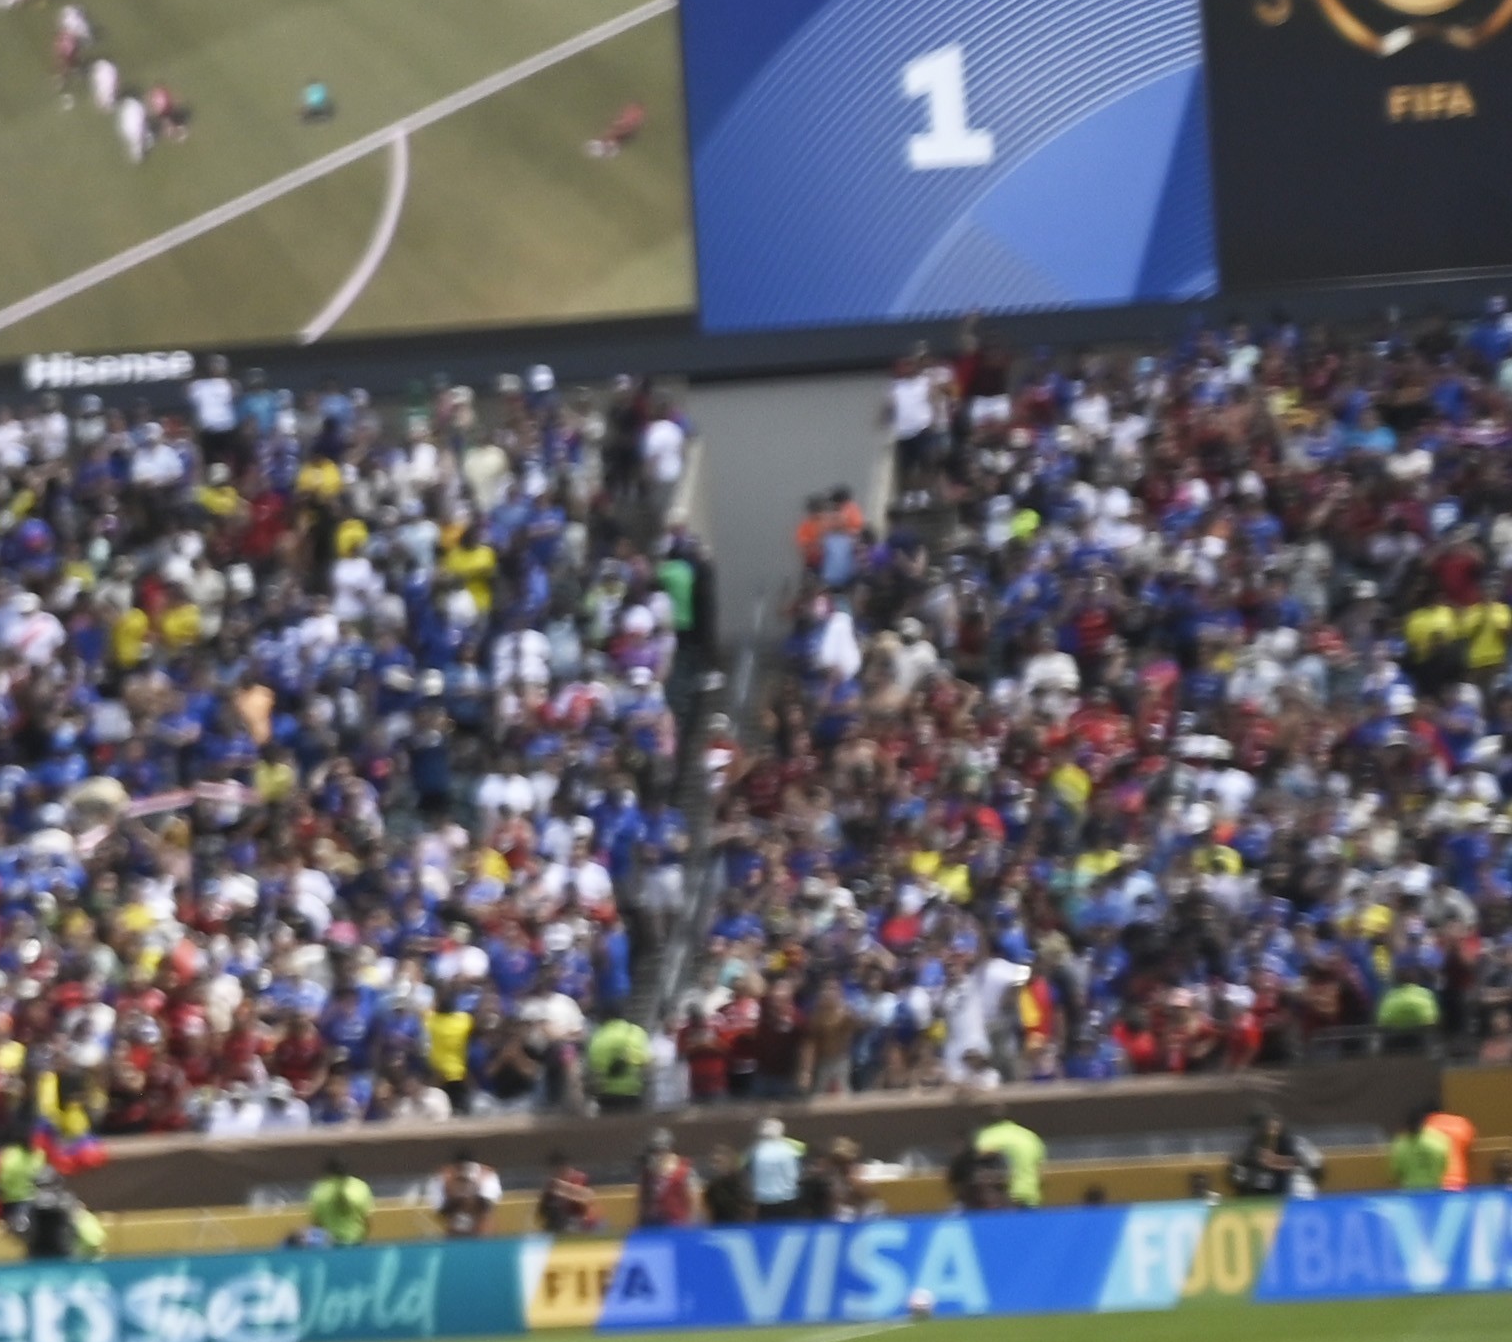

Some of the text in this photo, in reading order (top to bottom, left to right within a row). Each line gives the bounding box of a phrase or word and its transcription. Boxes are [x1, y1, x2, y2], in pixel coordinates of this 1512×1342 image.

[901, 42, 996, 172] 1
[1385, 80, 1478, 123] FIFA
[24, 349, 195, 390] Hisense
[704, 1217, 991, 1323] VISA
[1366, 1191, 1512, 1291] VI
[544, 1263, 655, 1308] FIFA
